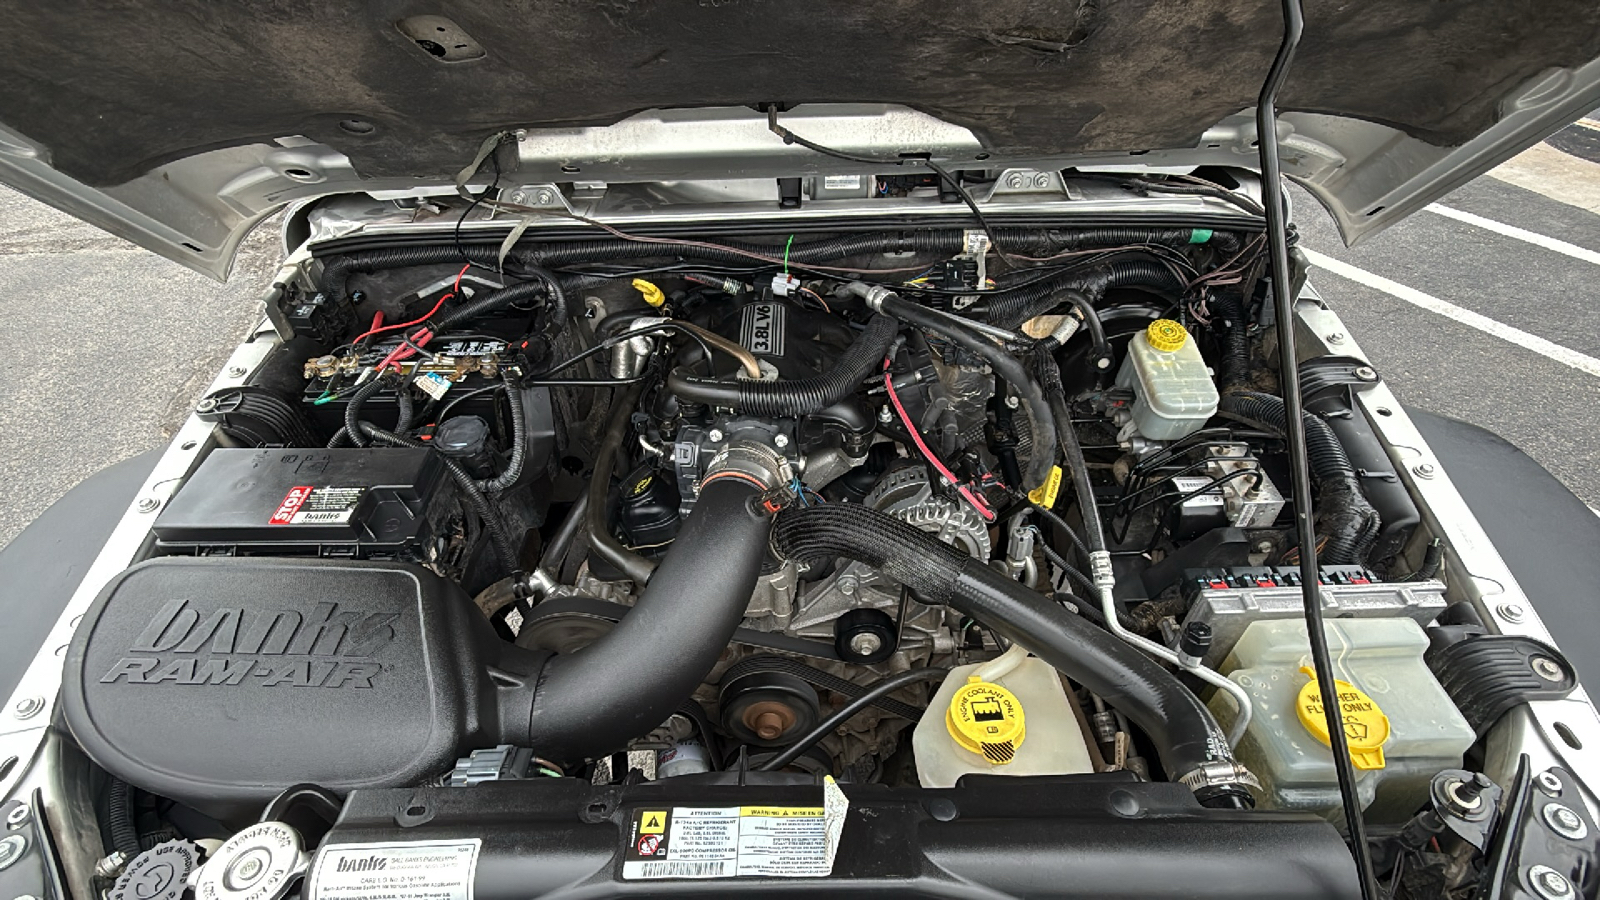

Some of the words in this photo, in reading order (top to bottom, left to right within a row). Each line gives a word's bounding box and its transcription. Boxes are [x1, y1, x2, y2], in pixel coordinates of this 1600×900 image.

[757, 305, 770, 322] V6
[755, 322, 770, 350] 3.8L
[275, 489, 302, 520] STOP
[130, 599, 400, 657] banks
[99, 657, 382, 689] RAM-AIR
[960, 697, 971, 722] ENGINE
[967, 688, 1004, 699] COOLANT
[1003, 699, 1015, 719] ONLY
[1308, 693, 1360, 703] WHER
[1343, 702, 1373, 712] ONLY
[337, 855, 388, 873] banks
